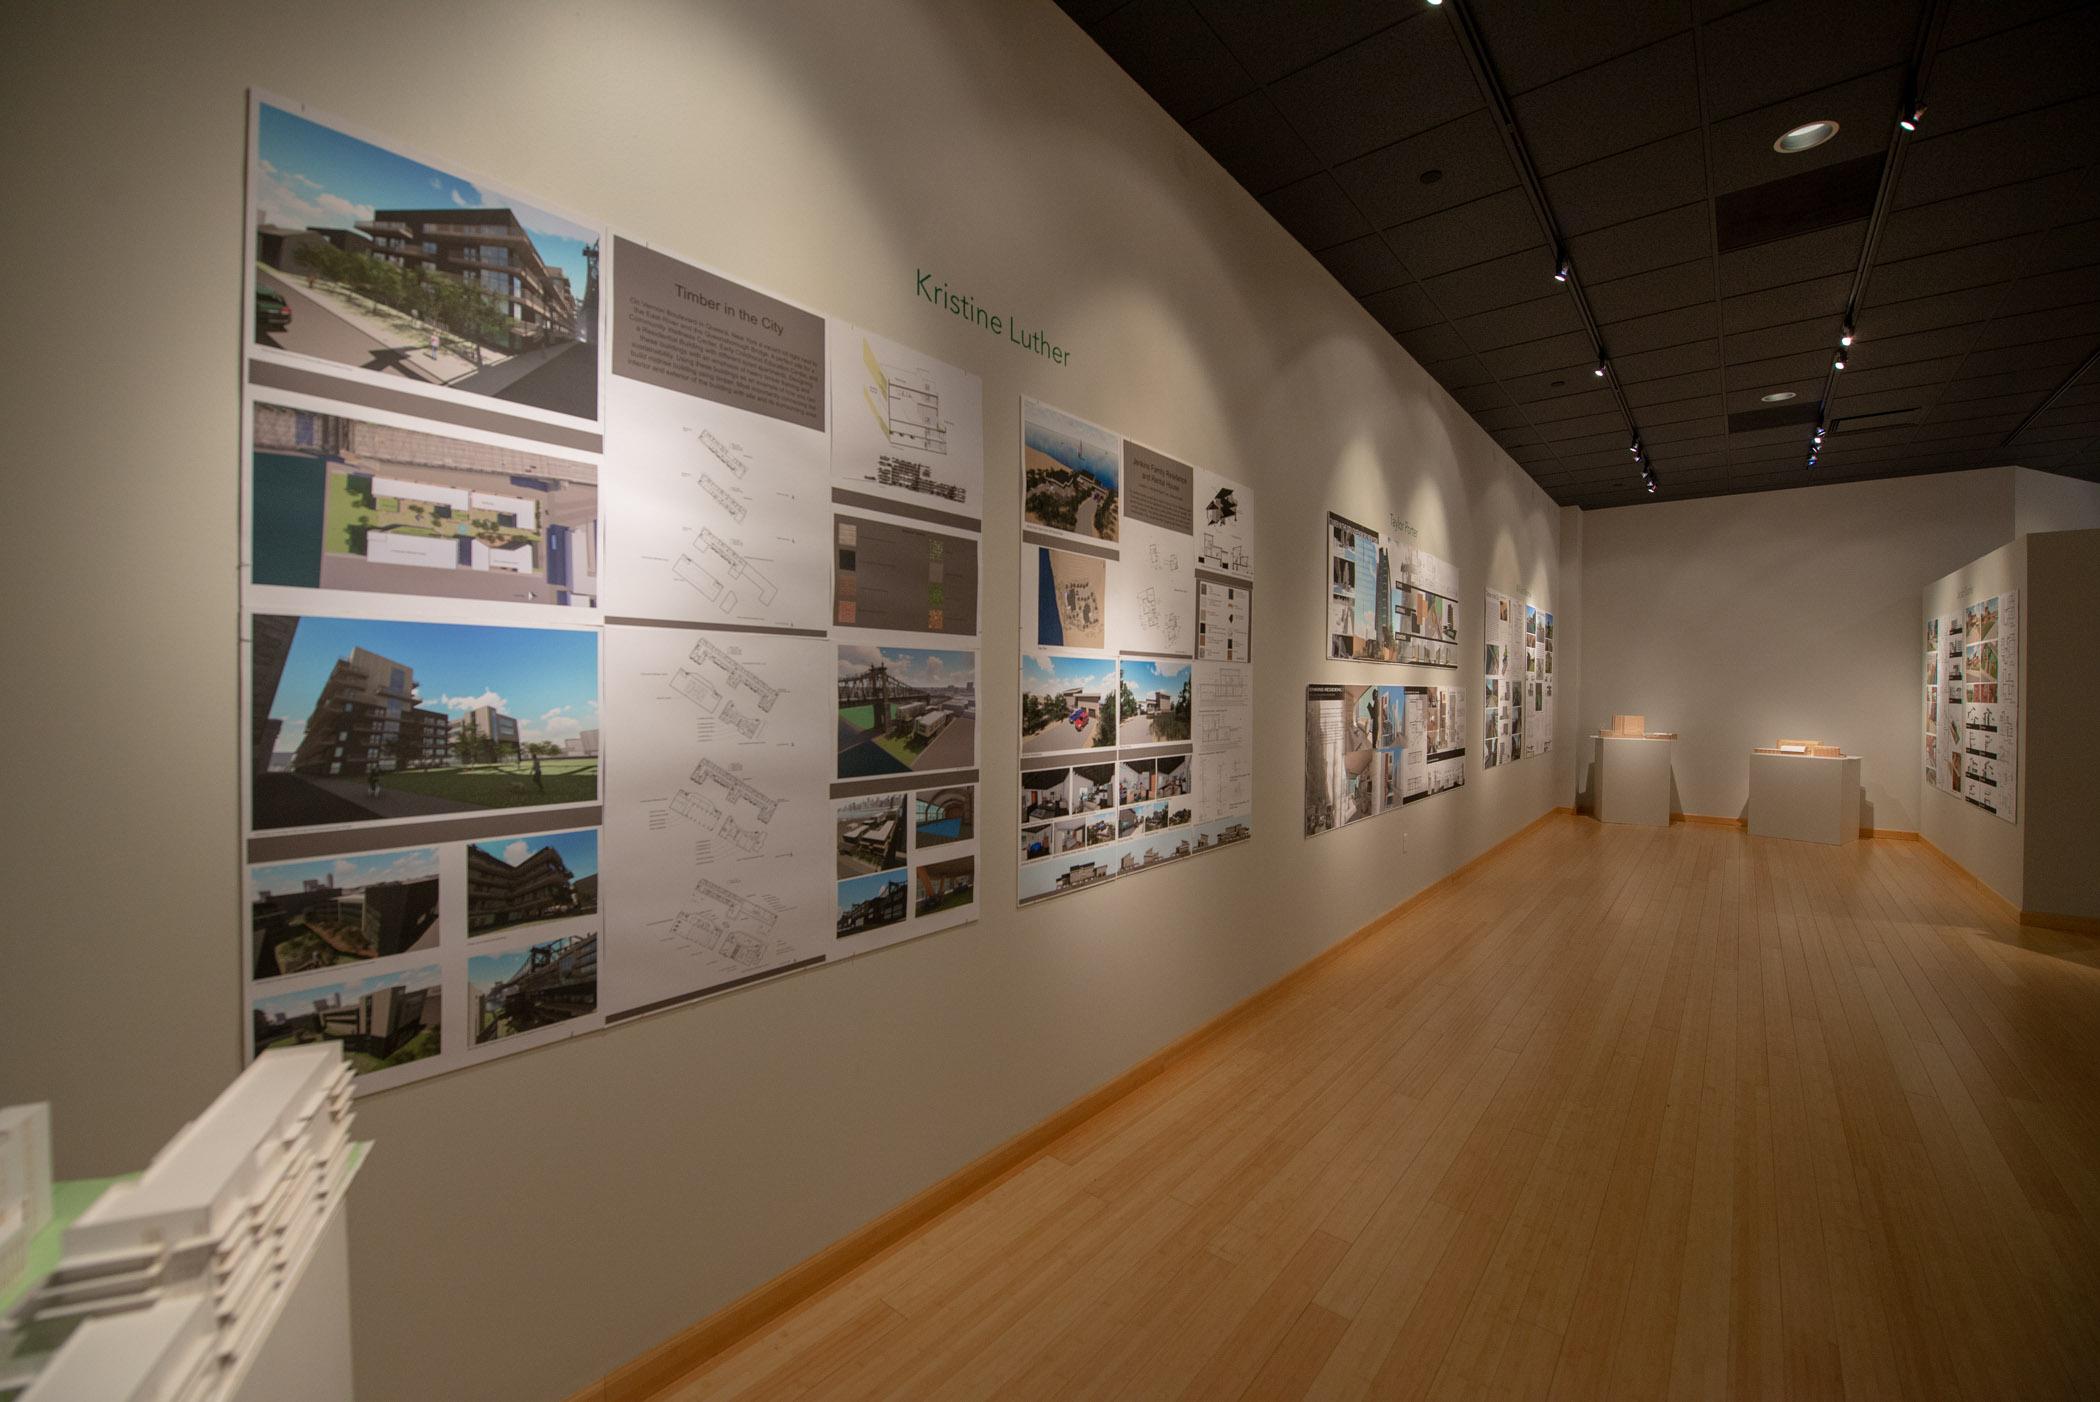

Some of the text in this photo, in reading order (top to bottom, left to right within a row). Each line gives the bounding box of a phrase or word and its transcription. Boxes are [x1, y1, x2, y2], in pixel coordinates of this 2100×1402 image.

[675, 283, 720, 312] Timber
[724, 303, 736, 316] in
[739, 308, 758, 325] the
[761, 317, 784, 336] City
[916, 268, 1070, 368] Kristine Luther
